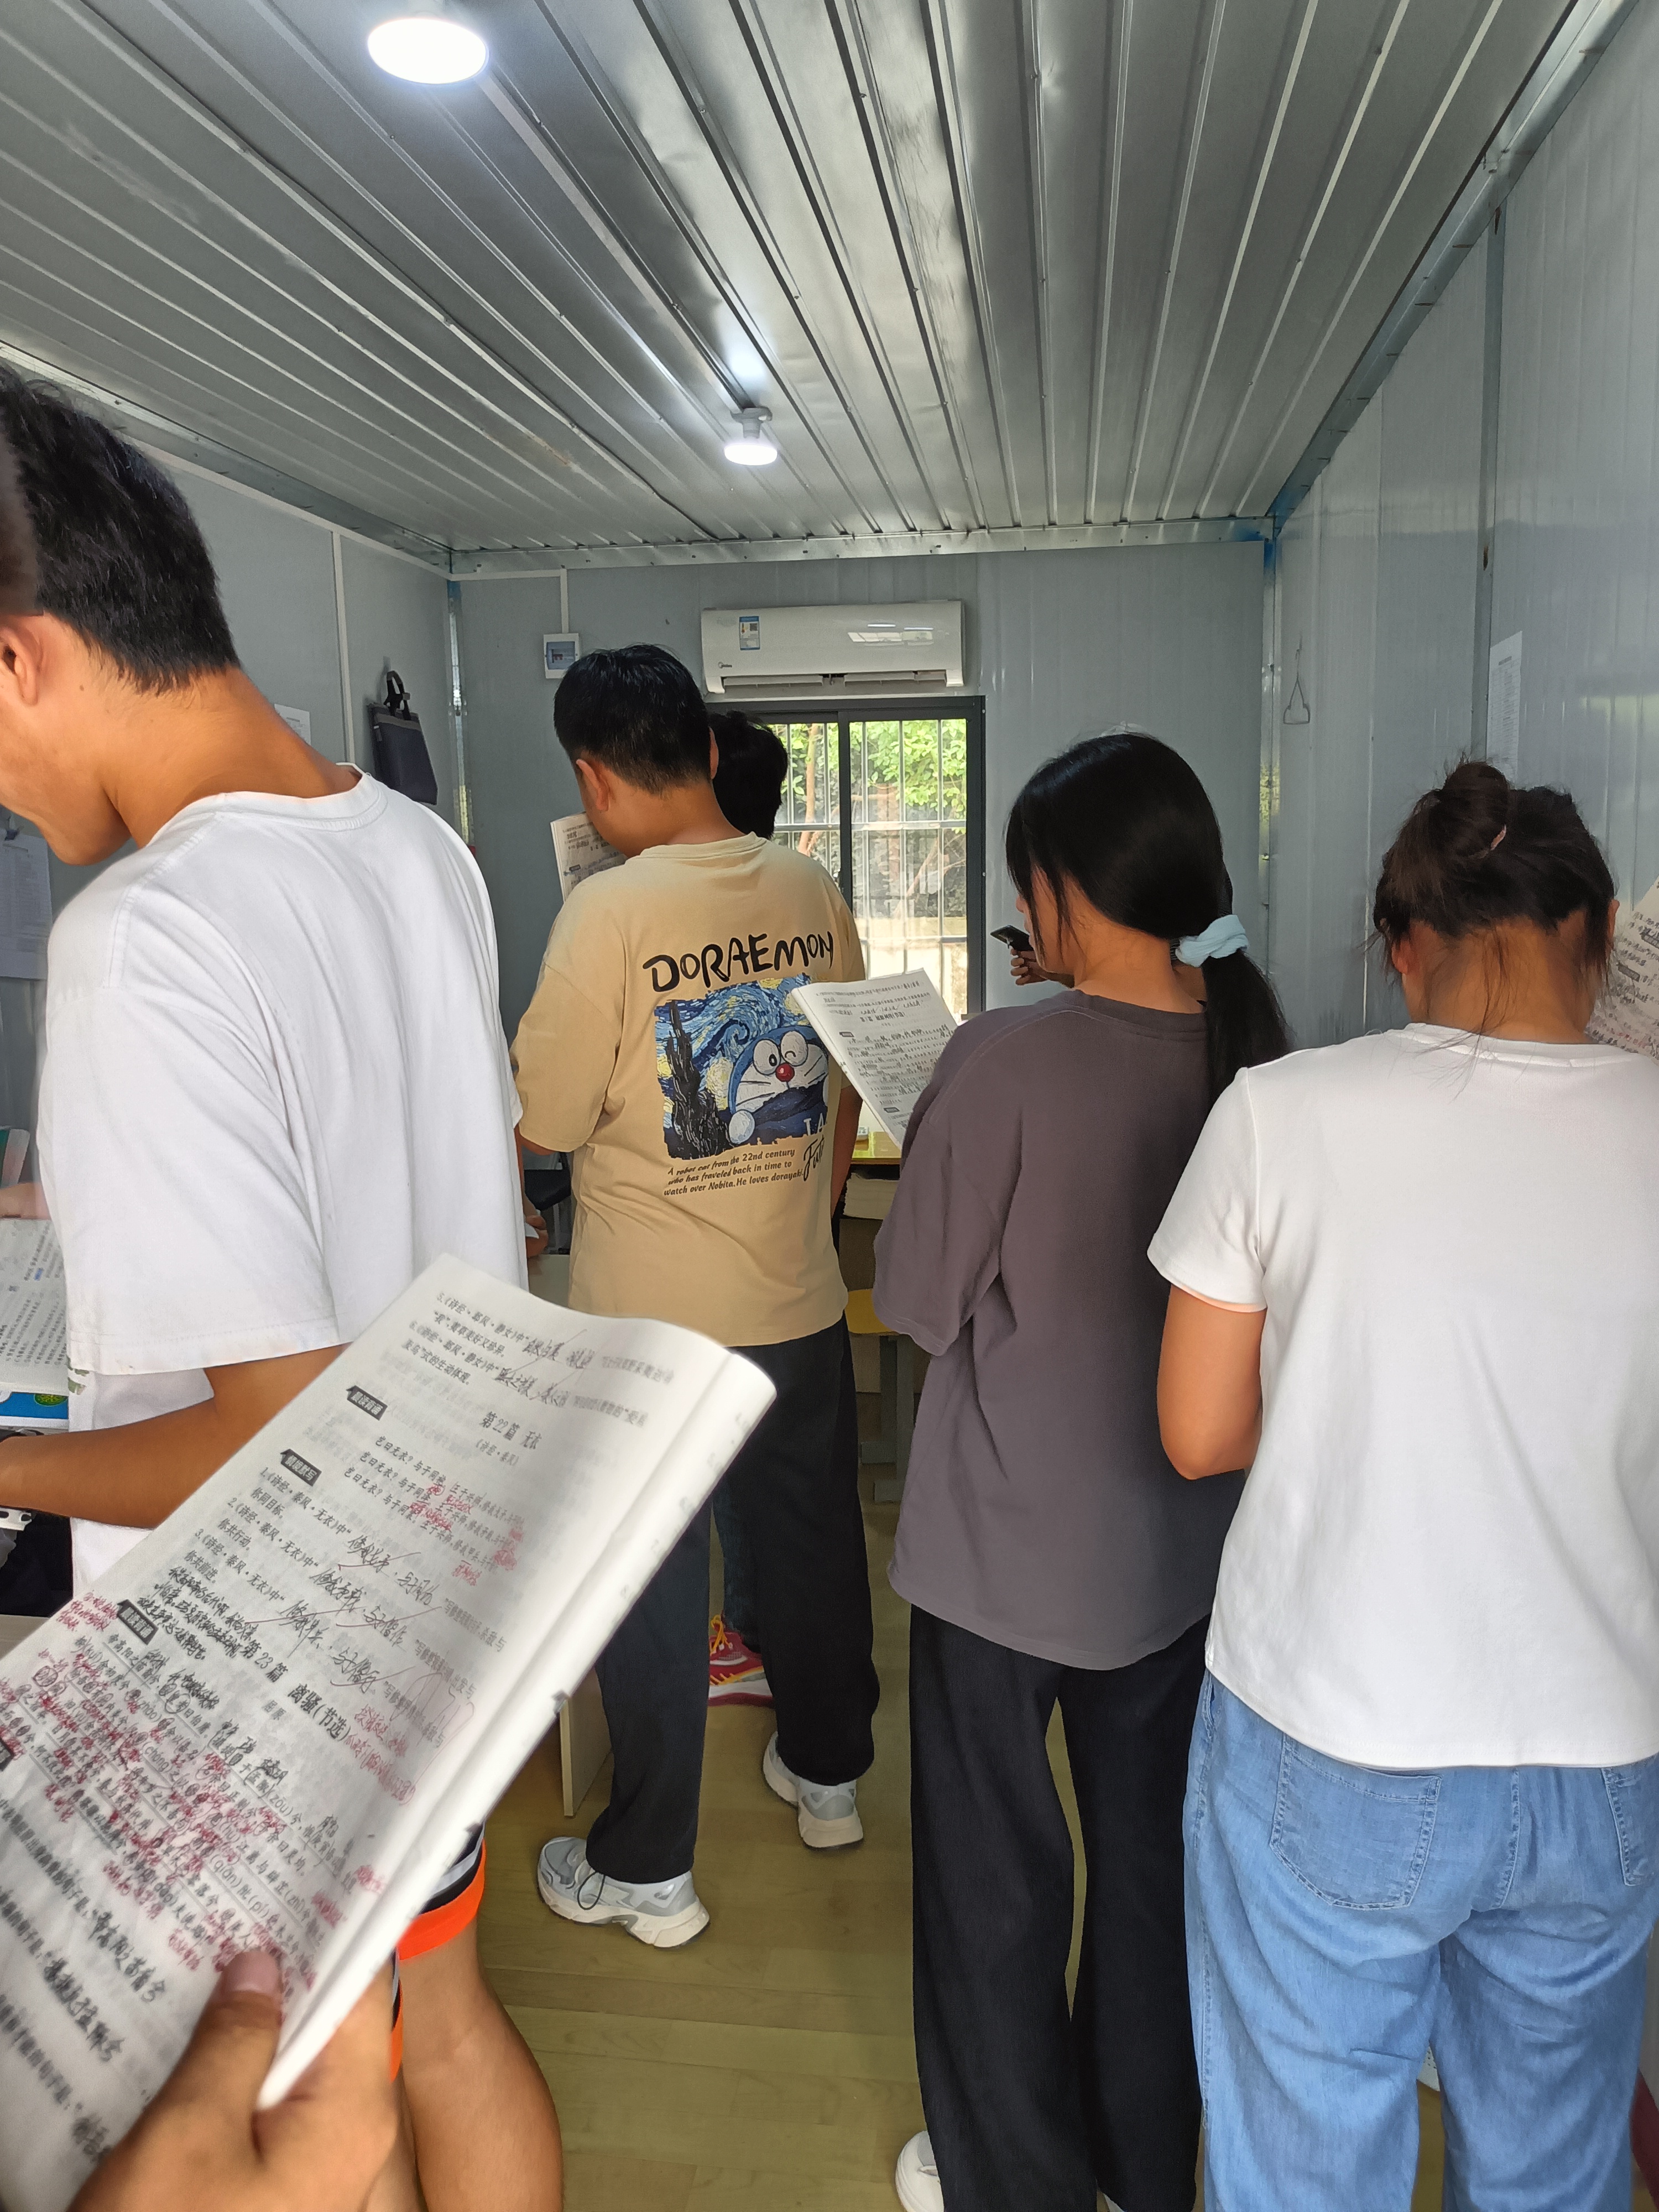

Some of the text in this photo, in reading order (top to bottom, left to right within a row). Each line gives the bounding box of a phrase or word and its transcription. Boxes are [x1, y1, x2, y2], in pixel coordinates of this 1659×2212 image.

[643, 931, 834, 992] DORAEMON
[667, 1167, 674, 1175] A
[676, 1166, 696, 1175] robot
[711, 1161, 729, 1170] from
[730, 1155, 739, 1165] the
[742, 1151, 763, 1161] 22nd
[765, 1149, 795, 1157] century
[668, 1177, 684, 1185] who
[732, 1164, 752, 1175] back
[754, 1164, 761, 1172] in
[764, 1162, 781, 1171] time
[664, 1185, 687, 1196] watch
[749, 1176, 769, 1185] loves
[349, 1390, 384, 1416] 晨读背诵
[284, 1454, 317, 1481] 情境默写
[251, 1486, 285, 1519] 你同目标。
[217, 1518, 252, 1551] 你共行动。
[184, 1550, 217, 1584] 你共前进。
[121, 1607, 154, 1639] 晨读背诵
[262, 1699, 287, 1722] 屈原
